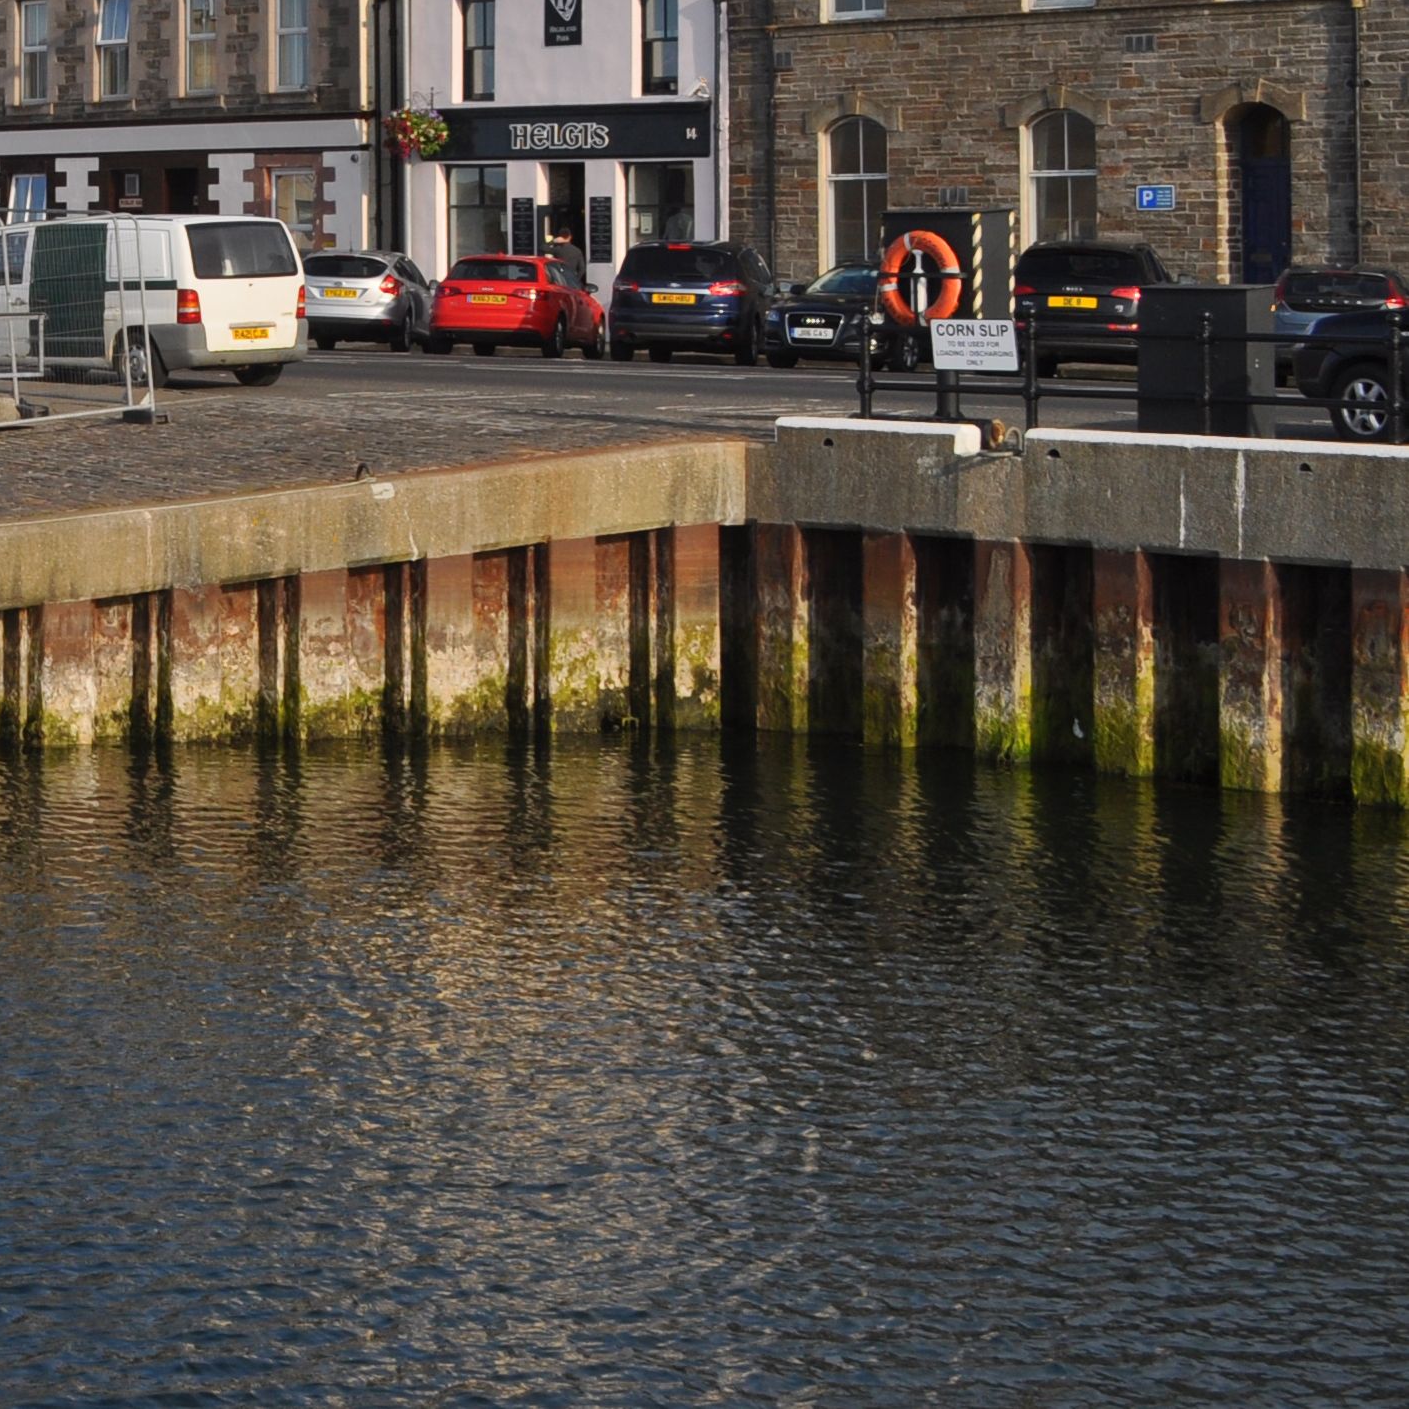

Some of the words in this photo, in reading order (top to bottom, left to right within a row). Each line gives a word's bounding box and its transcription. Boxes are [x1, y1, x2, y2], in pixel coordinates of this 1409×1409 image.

[686, 128, 697, 140] 14
[1142, 190, 1153, 206] P
[936, 324, 975, 337] CORN
[979, 325, 1009, 337] SLIP
